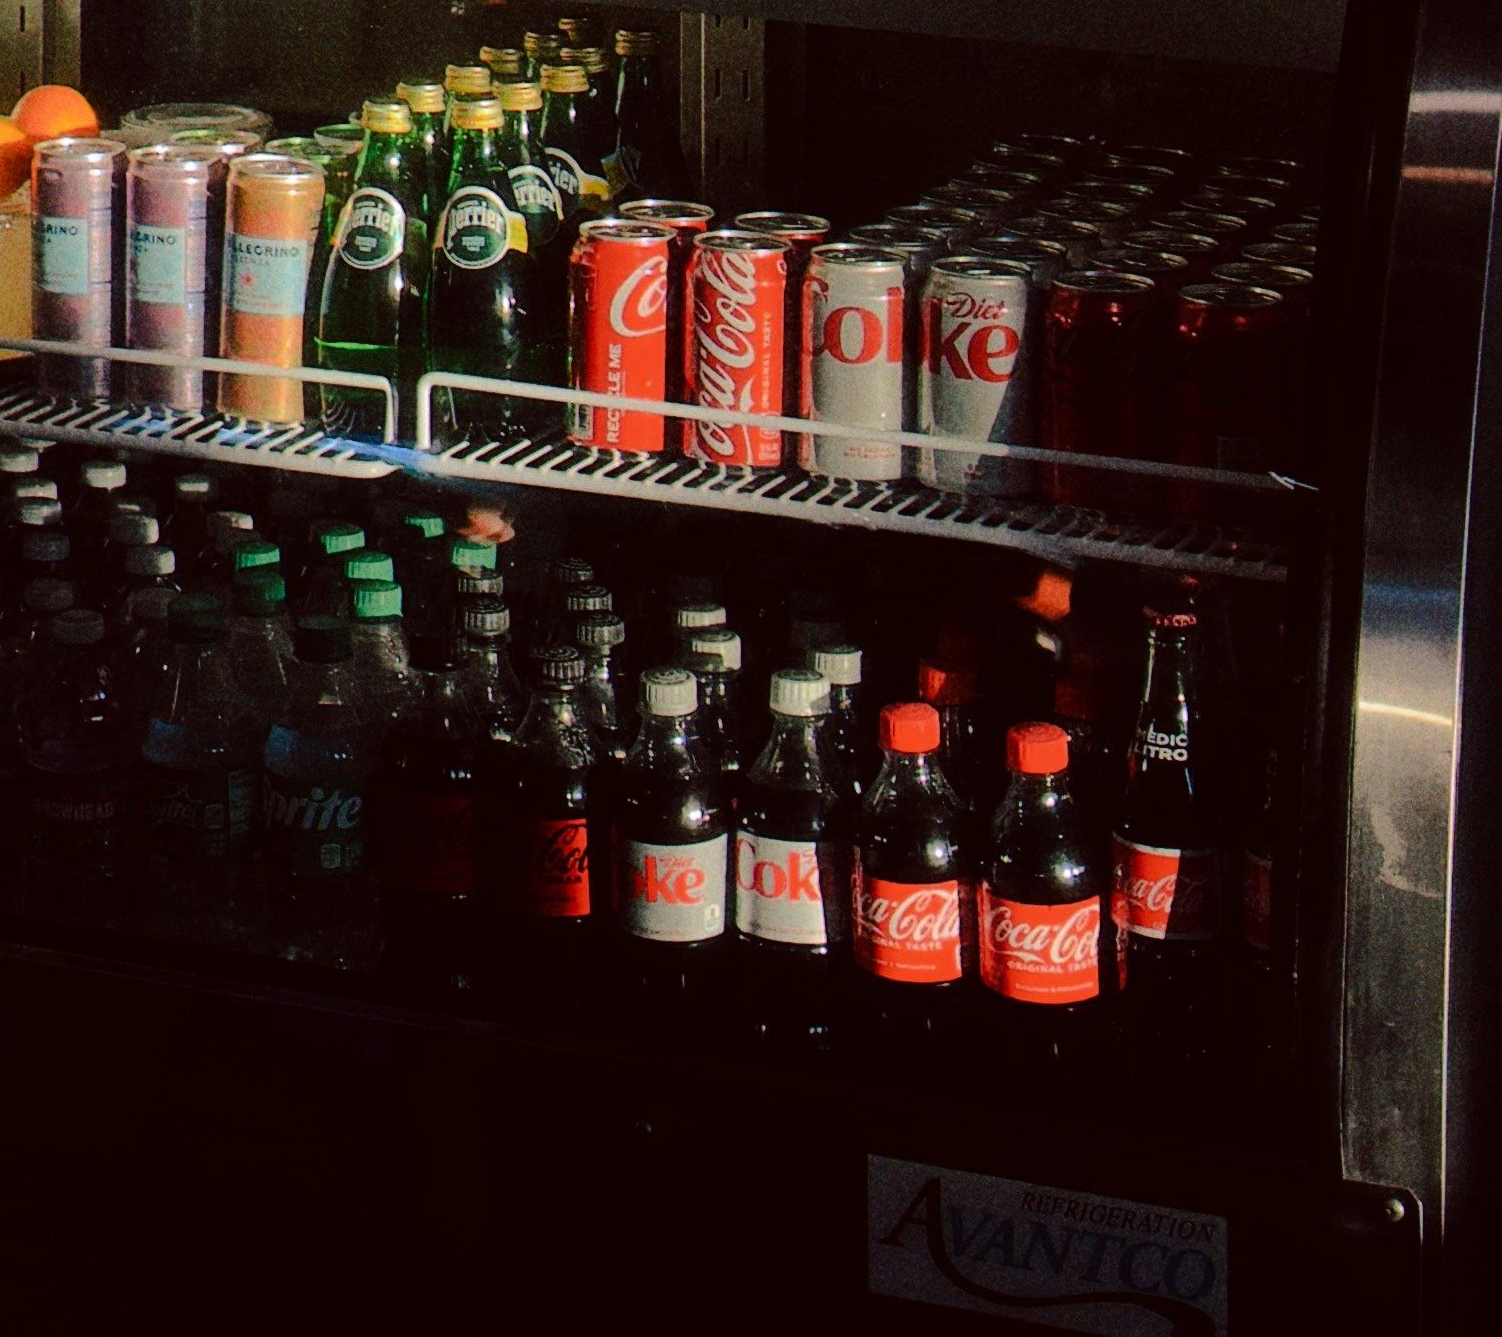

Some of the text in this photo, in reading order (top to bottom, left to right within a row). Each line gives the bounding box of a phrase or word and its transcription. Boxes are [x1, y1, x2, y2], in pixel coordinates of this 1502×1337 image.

[943, 291, 1010, 320] Diet
[925, 297, 1020, 383] ke
[606, 369, 622, 443] RECLE
[736, 837, 823, 903] Cok
[987, 904, 1100, 965] Coca-Col
[1007, 960, 1065, 975] ORIGINAL
[876, 1176, 1217, 1302] AVANTCO
[1021, 1190, 1218, 1244] REFRIGERATION
